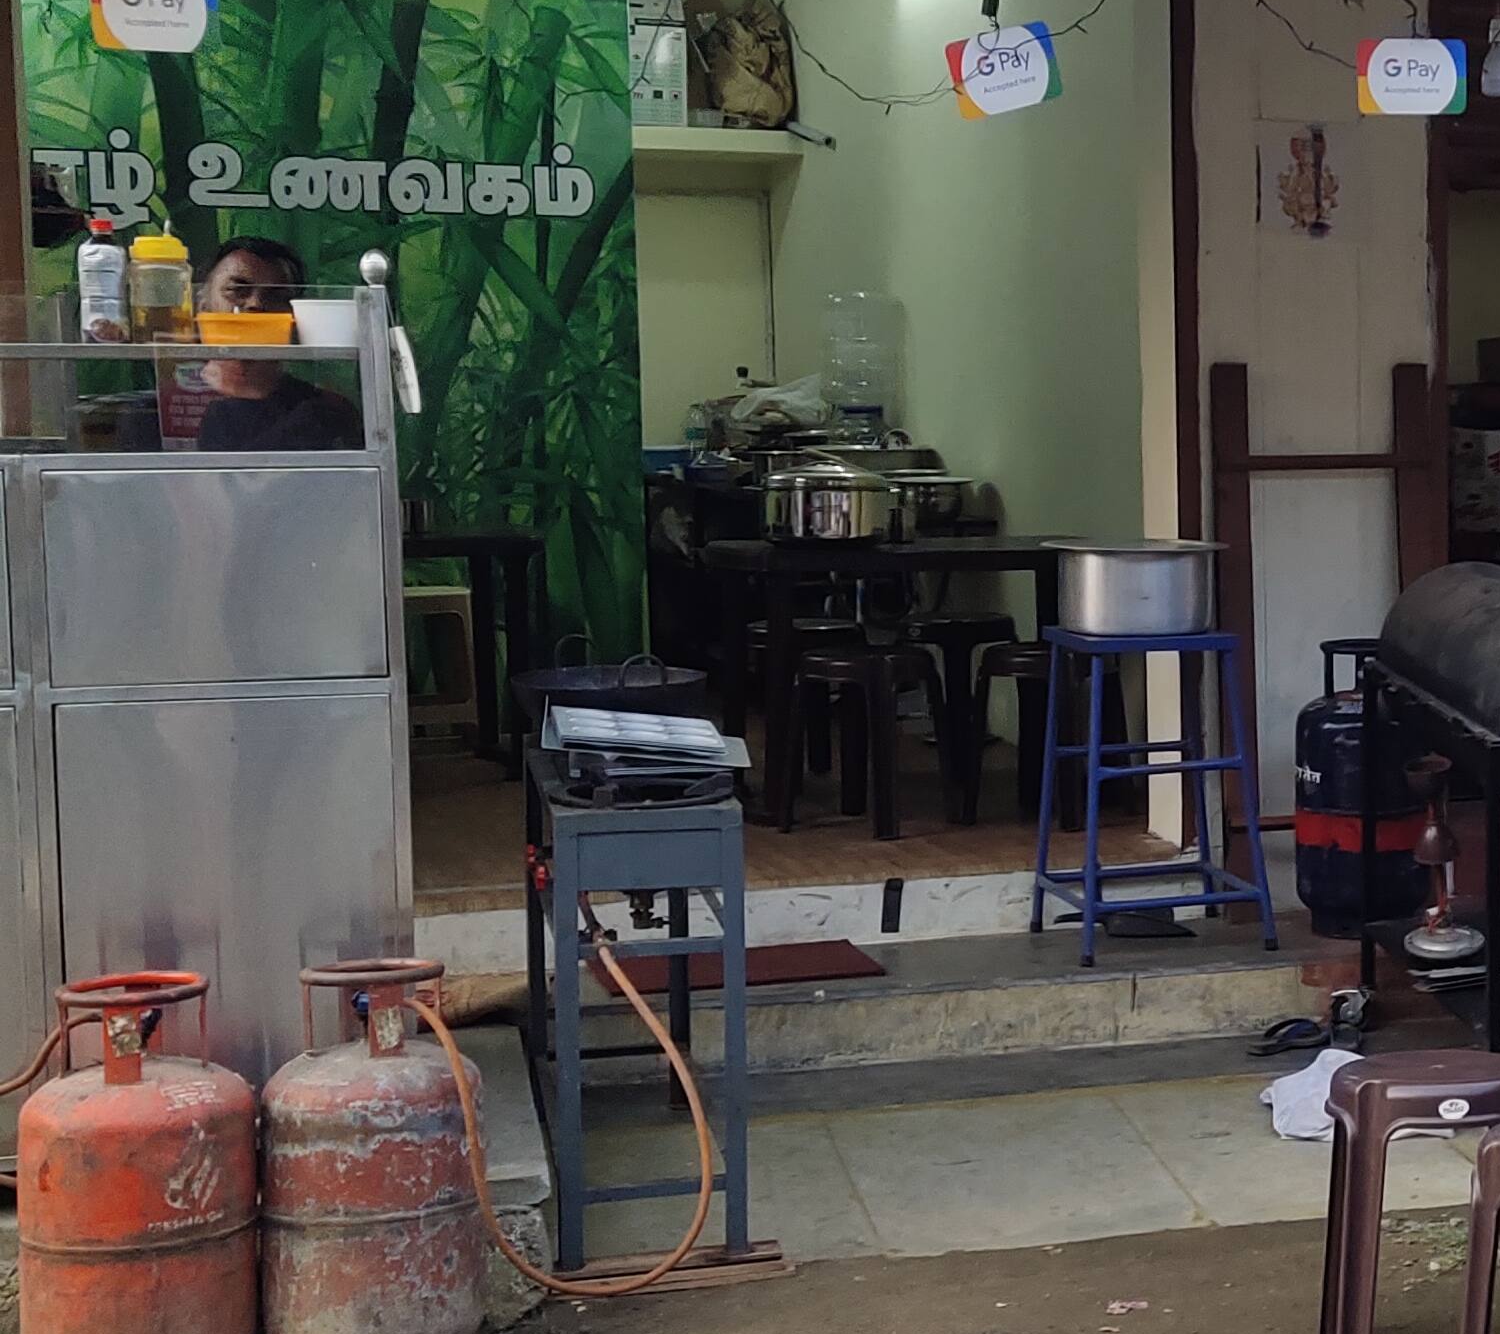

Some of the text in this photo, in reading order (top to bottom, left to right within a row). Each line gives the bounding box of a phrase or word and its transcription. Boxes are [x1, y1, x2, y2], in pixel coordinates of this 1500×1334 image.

[977, 50, 1031, 77] G Pay
[1383, 58, 1441, 82] G Pay
[187, 141, 595, 218] உணவகம்
